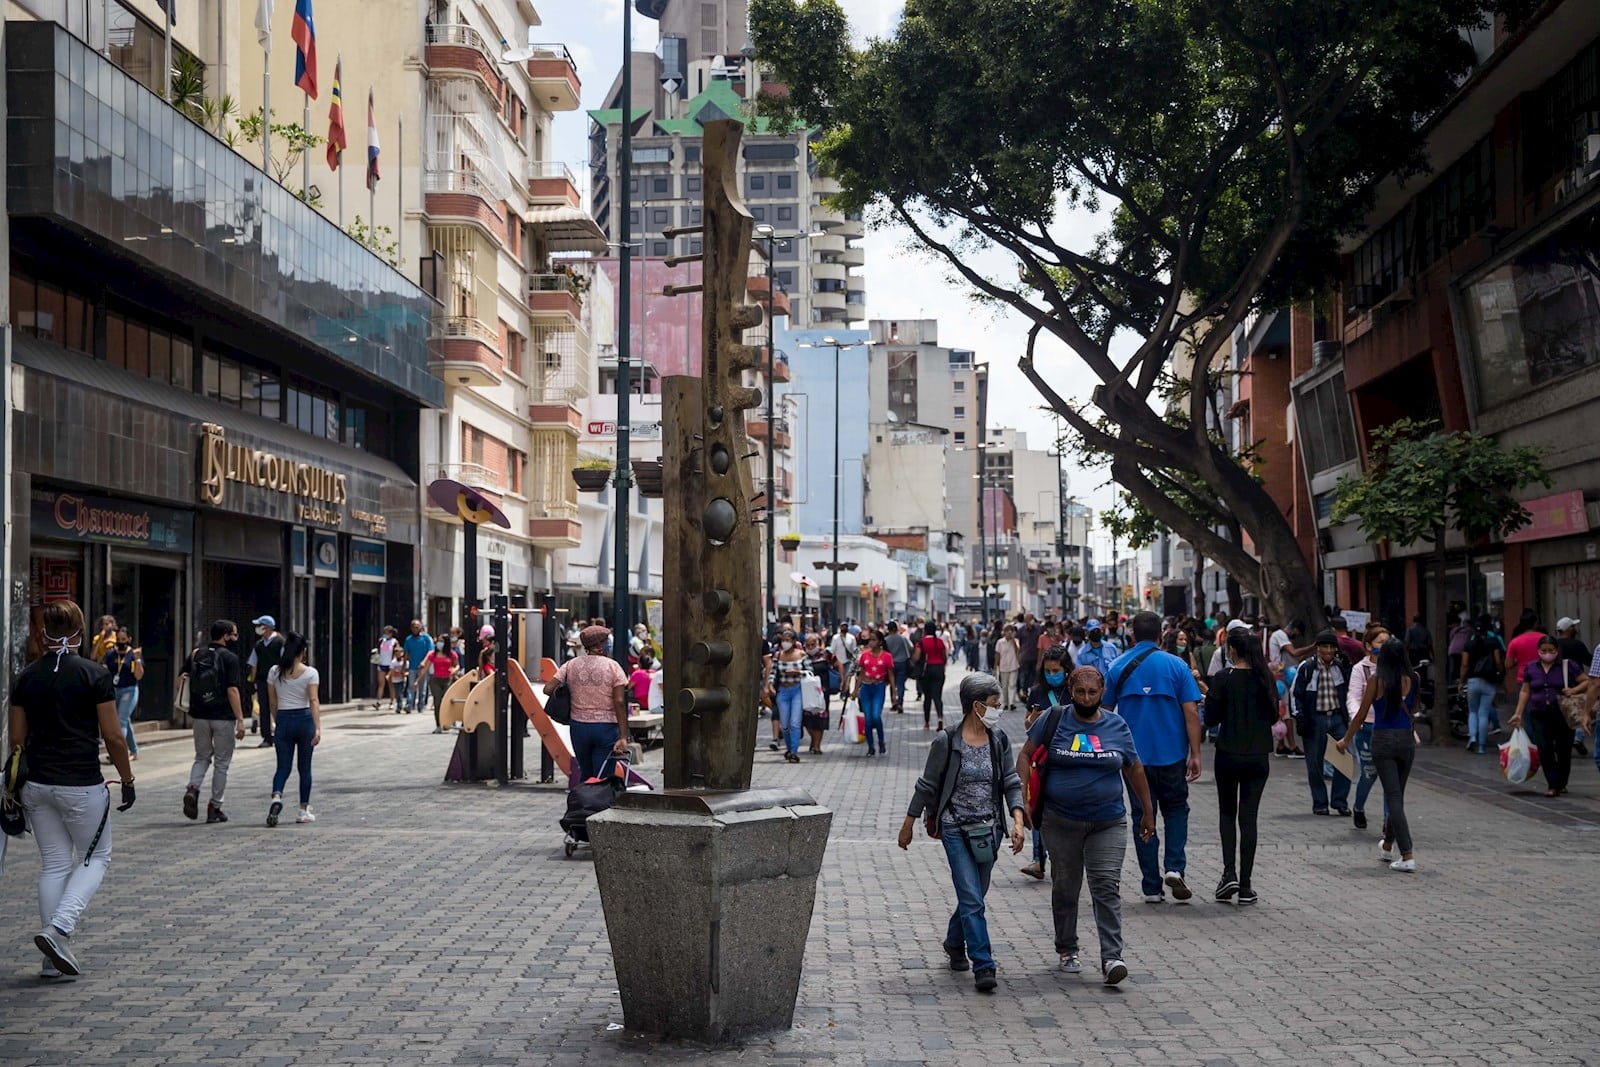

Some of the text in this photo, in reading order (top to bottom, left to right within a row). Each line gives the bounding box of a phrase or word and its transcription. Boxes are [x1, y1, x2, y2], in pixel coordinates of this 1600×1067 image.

[225, 442, 347, 505] LINCOLN SUITES
[54, 493, 150, 540] Chaumet
[1056, 749, 1095, 758] Trabajamos
